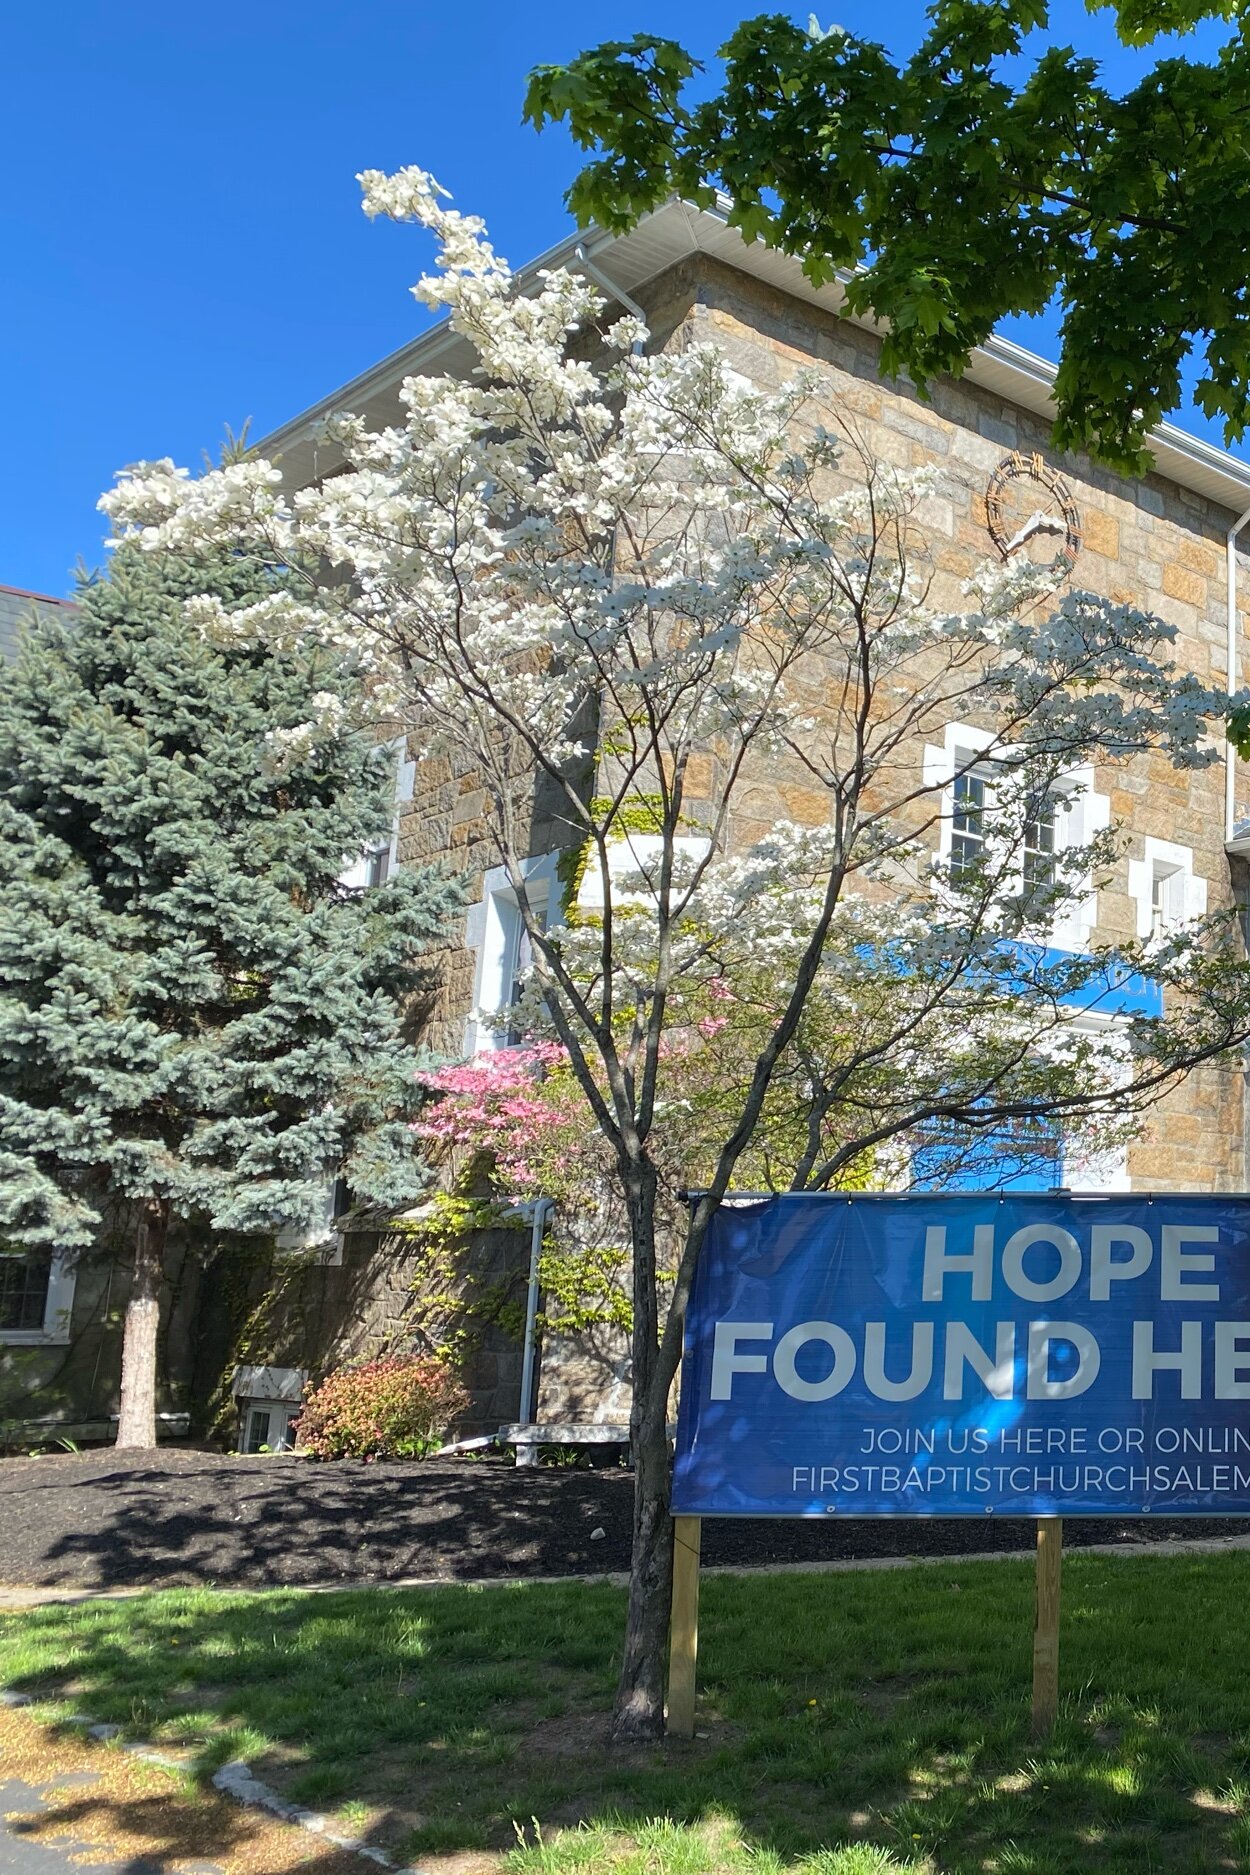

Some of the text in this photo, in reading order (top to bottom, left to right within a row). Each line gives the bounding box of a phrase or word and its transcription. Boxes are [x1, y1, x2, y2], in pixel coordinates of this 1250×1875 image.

[922, 1224, 1220, 1302] HOPE
[710, 1321, 1101, 1402] FOUND
[860, 1428, 935, 1455] JOIN
[948, 1428, 989, 1454] US
[1000, 1428, 1087, 1454] HERE
[1098, 1427, 1145, 1454] OR
